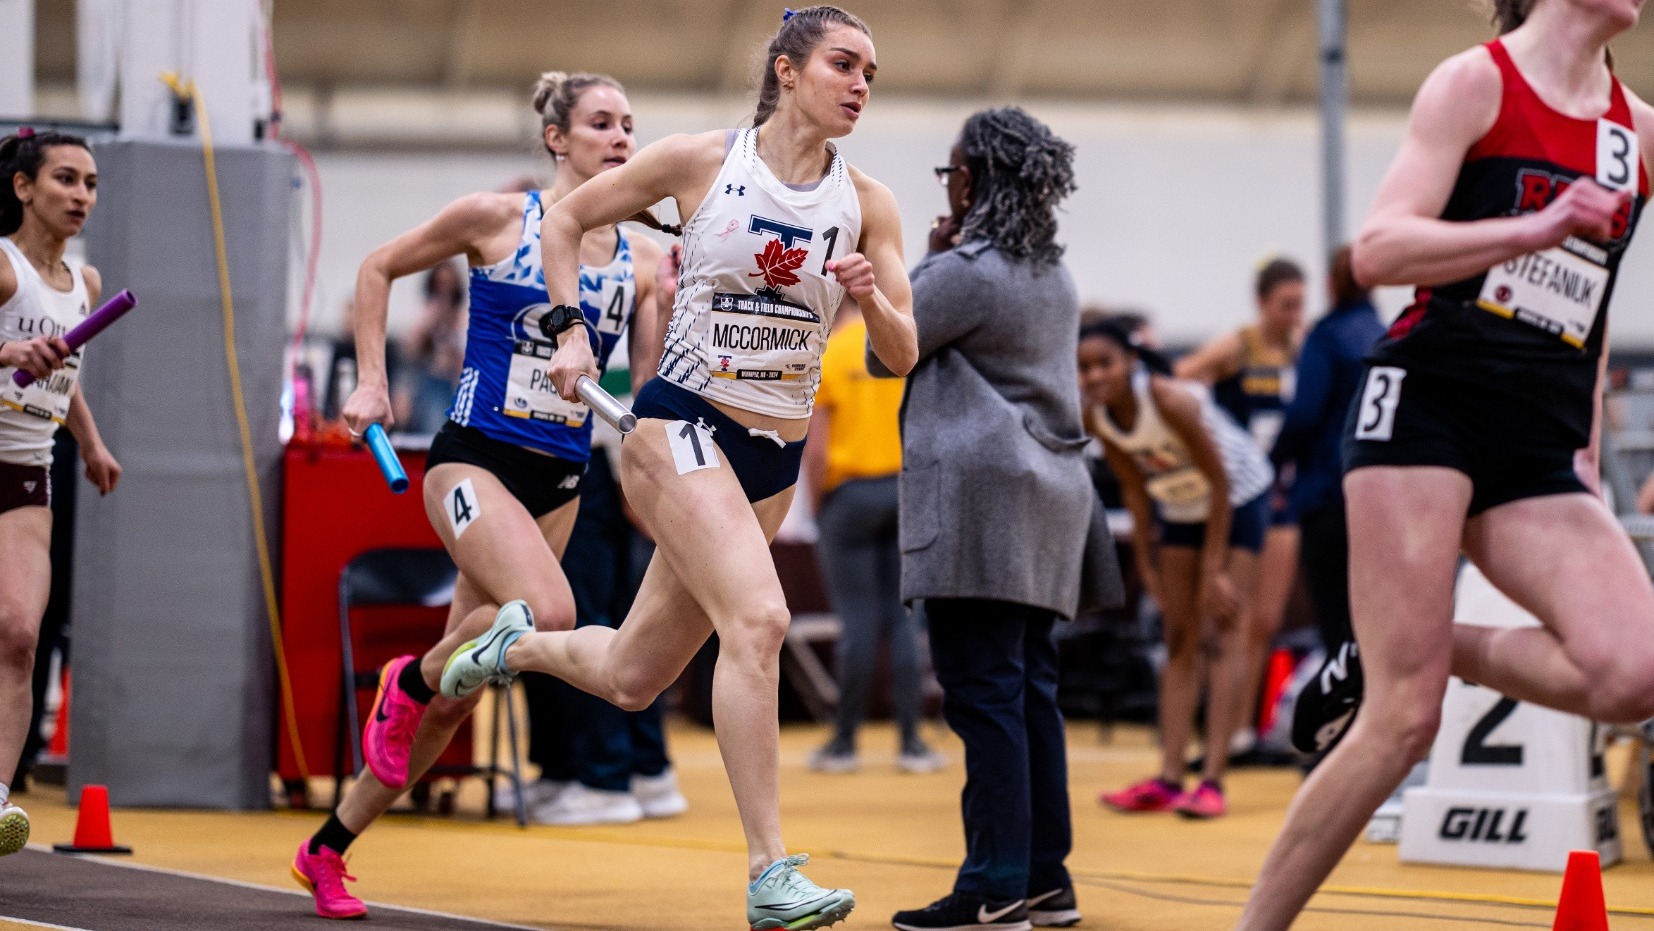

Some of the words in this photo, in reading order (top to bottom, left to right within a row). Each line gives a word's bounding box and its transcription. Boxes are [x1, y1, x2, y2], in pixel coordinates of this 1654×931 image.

[1608, 128, 1629, 185] 3
[820, 226, 839, 277] 1
[606, 285, 625, 332] 4
[737, 300, 754, 311] TRACK
[755, 302, 760, 312] &
[760, 303, 774, 314] FIELD
[712, 324, 812, 351] MCCORMICK
[1363, 373, 1391, 433] 3
[679, 423, 705, 467] 1
[454, 486, 472, 525] 4
[1438, 807, 1530, 844] GILL
